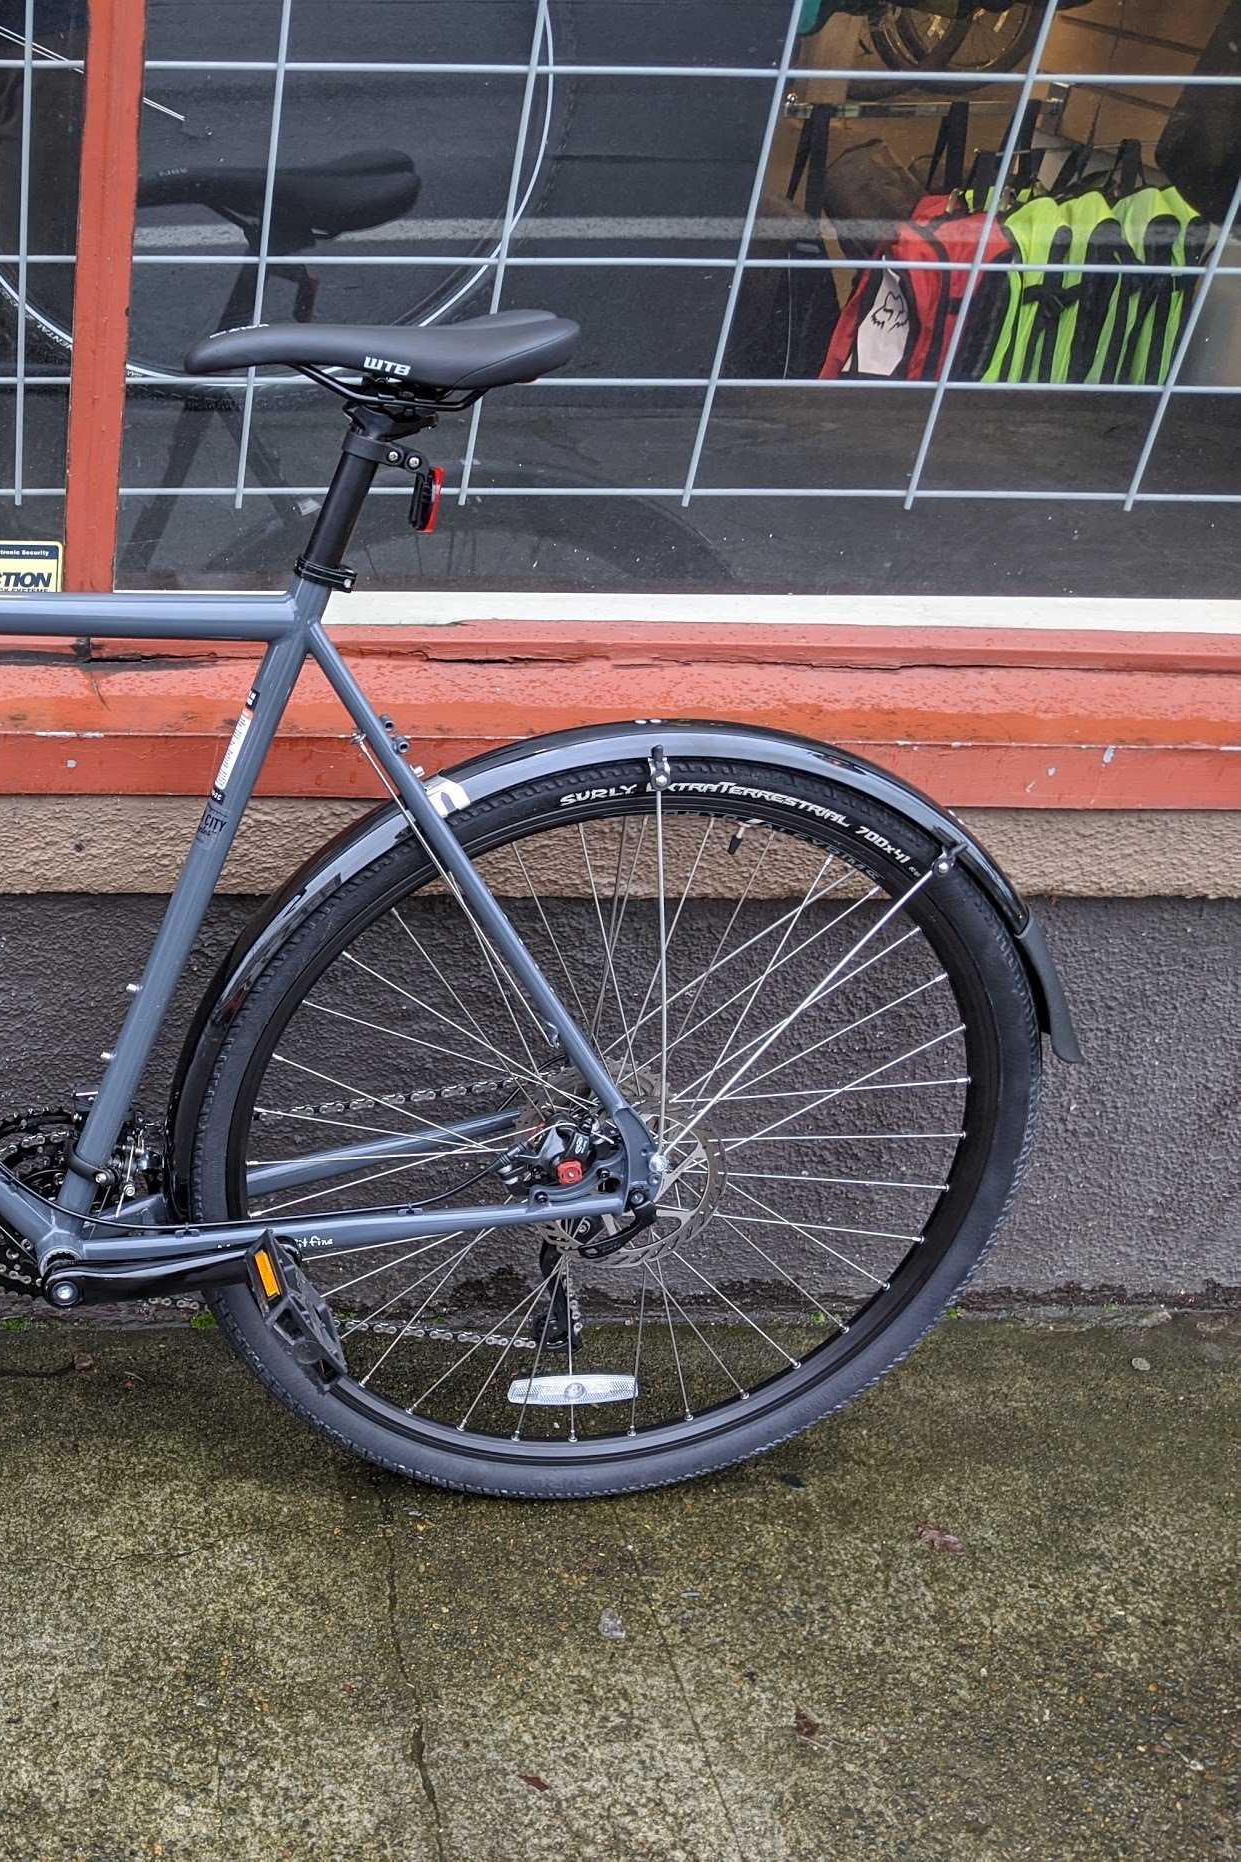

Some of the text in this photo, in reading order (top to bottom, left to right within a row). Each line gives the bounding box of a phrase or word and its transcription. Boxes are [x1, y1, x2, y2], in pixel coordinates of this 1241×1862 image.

[363, 356, 411, 376] WTB
[204, 813, 228, 833] CITY
[559, 784, 638, 807] SURLY
[855, 826, 912, 864] 700x41
[309, 1235, 334, 1247] fine
